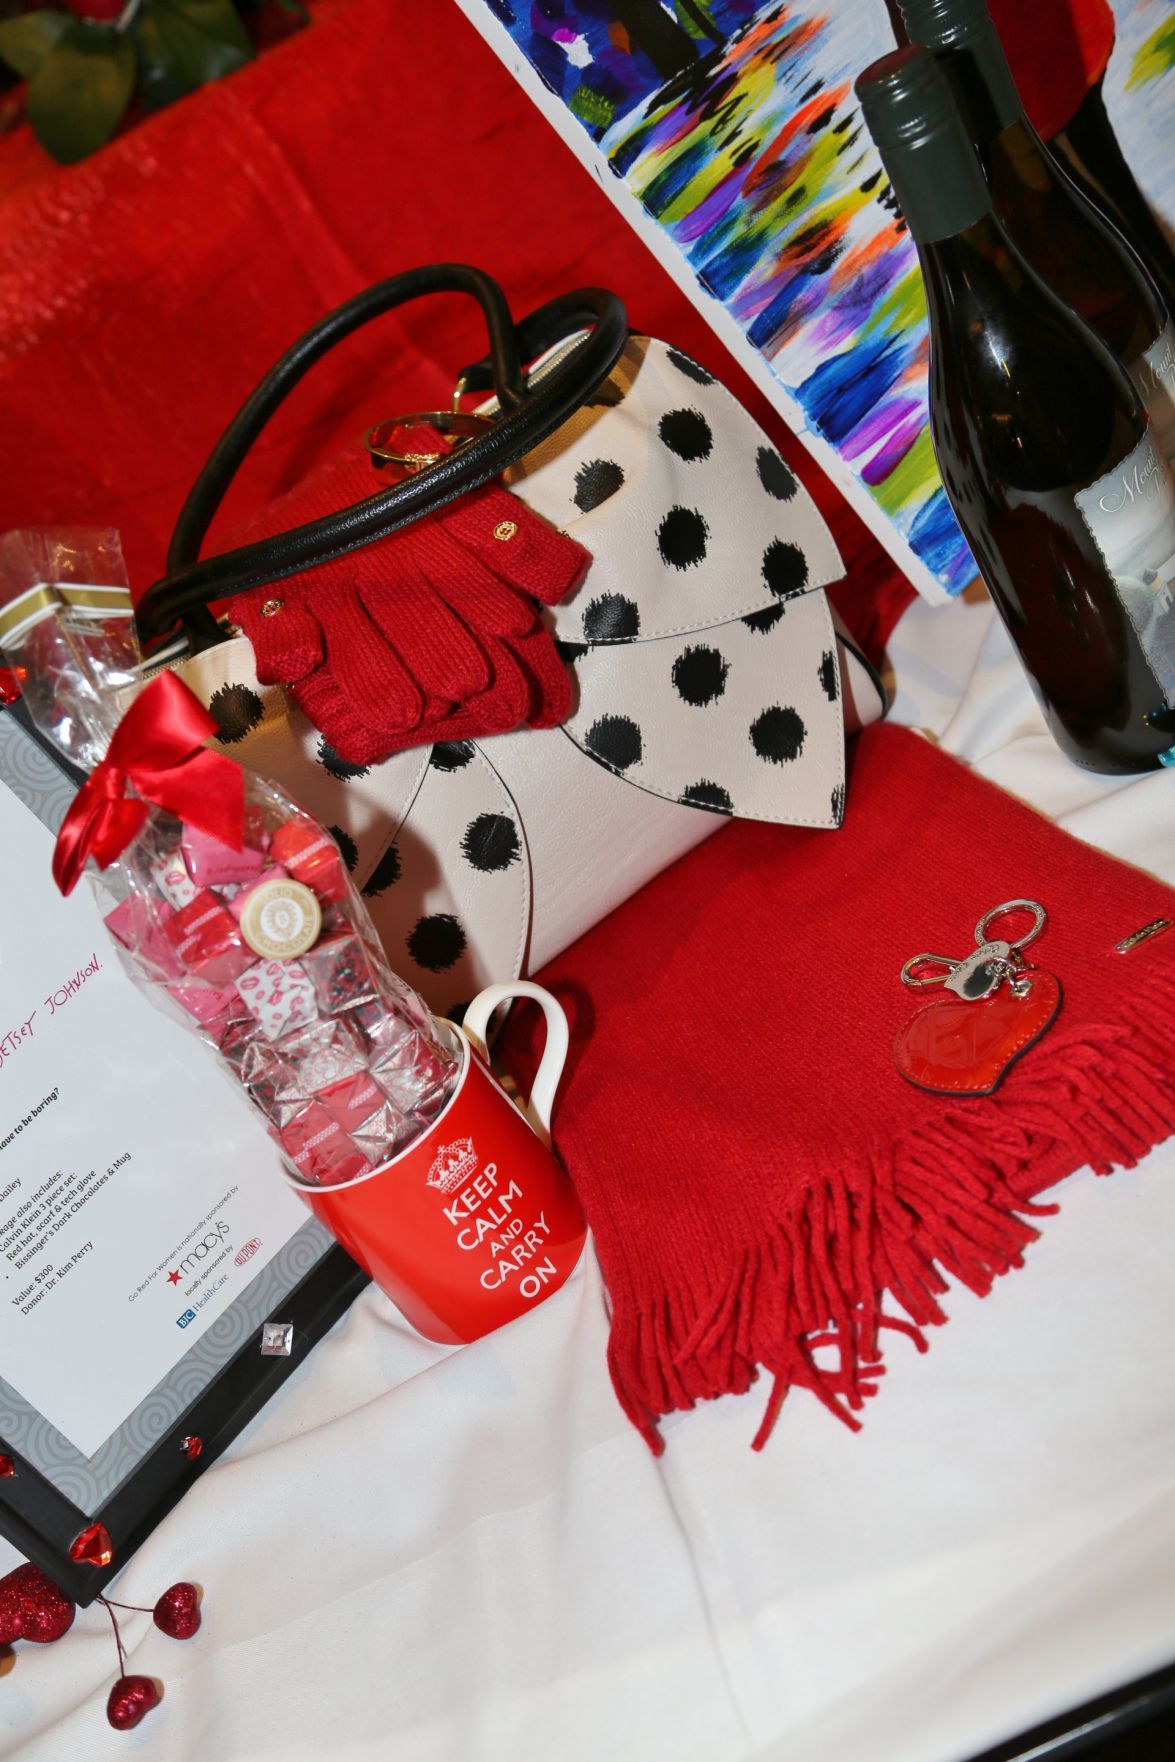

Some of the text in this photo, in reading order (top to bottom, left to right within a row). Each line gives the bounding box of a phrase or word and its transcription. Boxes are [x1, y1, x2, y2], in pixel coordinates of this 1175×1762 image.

[14, 1124, 24, 1134] to
[21, 1114, 33, 1127] be
[31, 1087, 60, 1118] boring?
[0, 1172, 78, 1252] Calvin Klein 3 piece set:
[6, 1169, 97, 1261] Red hat, scarf & tech glove
[14, 1151, 132, 1270] Bissinger's Dark Chocolates & Mug
[16, 1201, 32, 1218] also
[31, 1170, 64, 1203] includes:
[442, 1162, 498, 1226] KEEP
[456, 1179, 524, 1250] CALM
[128, 1291, 139, 1302] Go
[137, 1279, 150, 1293] Red
[149, 1270, 158, 1282] For
[156, 1249, 178, 1271] Women
[181, 1220, 207, 1247] nationally
[205, 1192, 231, 1221] sponsored
[230, 1185, 239, 1195] by
[479, 1210, 551, 1290] CARRY
[490, 1218, 524, 1258] AND
[12, 1264, 54, 1307] Value: $300
[20, 1240, 94, 1315] Donor: Dr. Kim Perry
[177, 1274, 230, 1328] BJC HealthCare
[184, 1244, 234, 1297] locally sponsored by
[519, 1256, 558, 1298] ON
